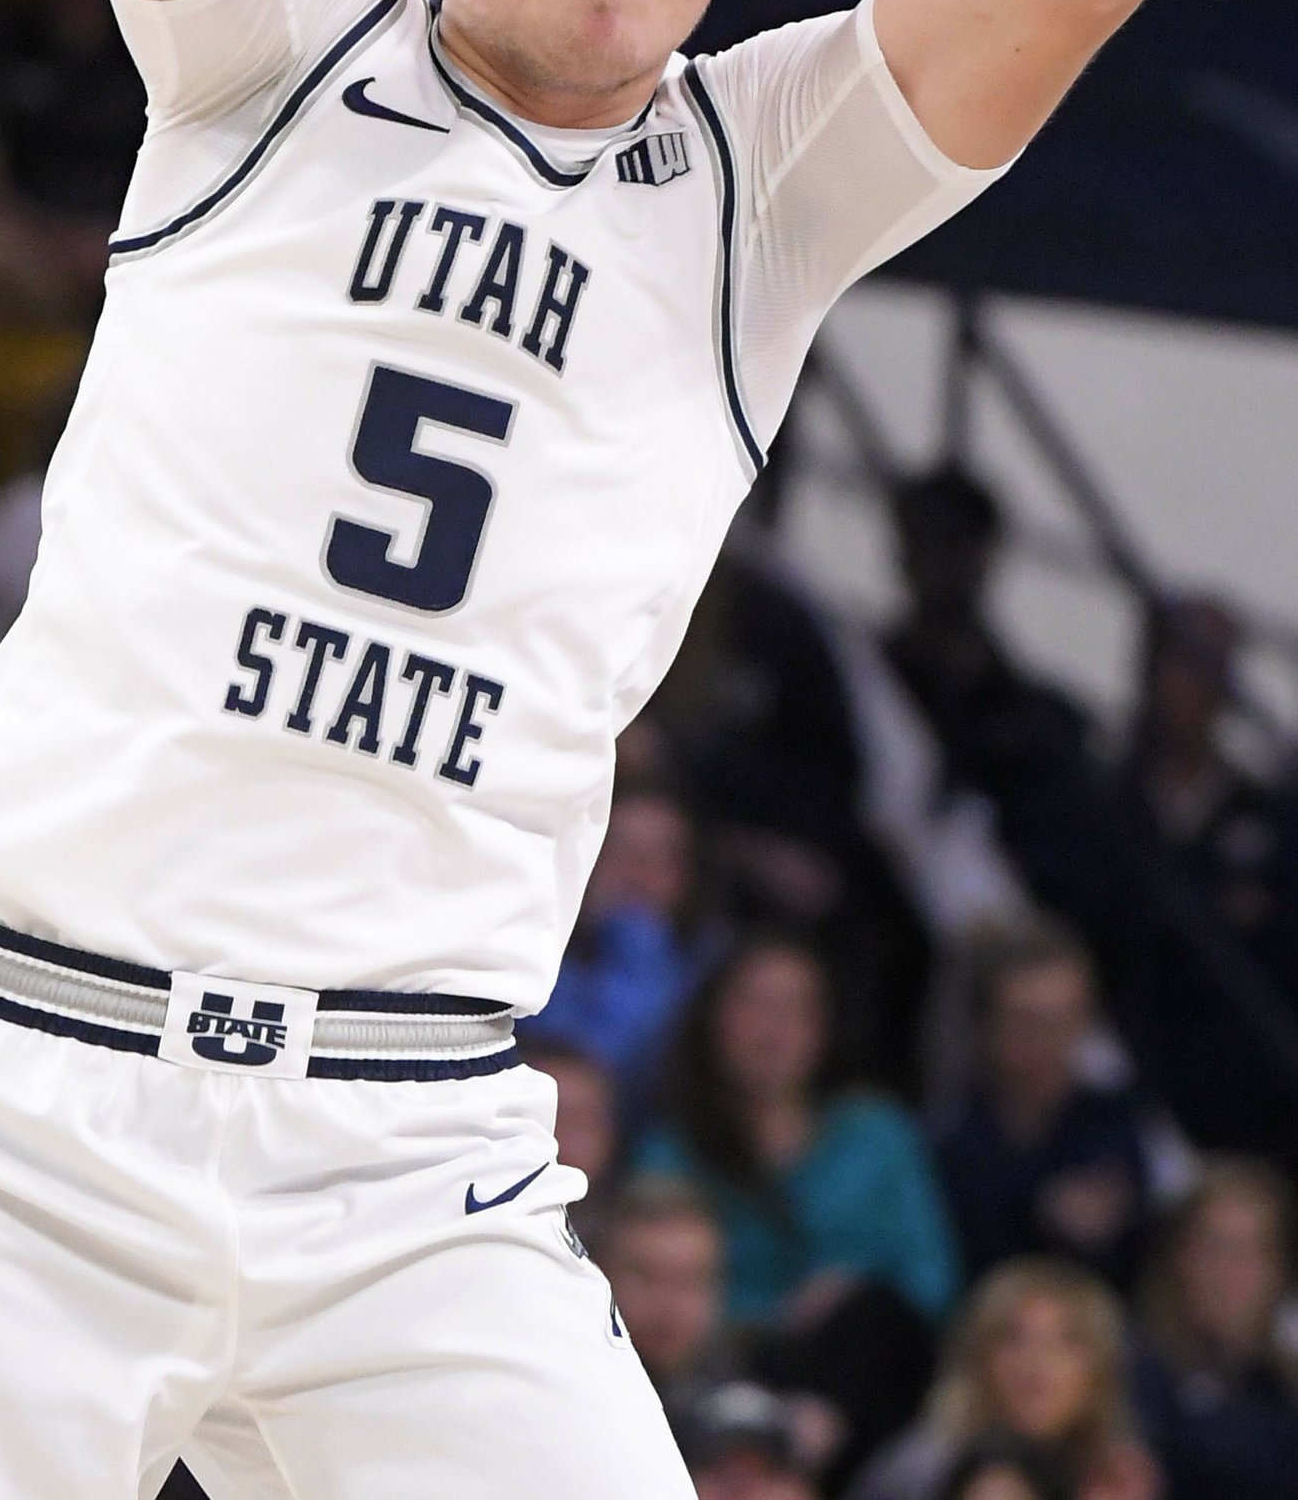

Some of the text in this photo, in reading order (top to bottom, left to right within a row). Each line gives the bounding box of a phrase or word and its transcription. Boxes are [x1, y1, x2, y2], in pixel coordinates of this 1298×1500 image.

[347, 197, 592, 379] UTAH
[319, 359, 520, 620] 5
[220, 606, 504, 790] STATE
[187, 1011, 288, 1050] STATE
